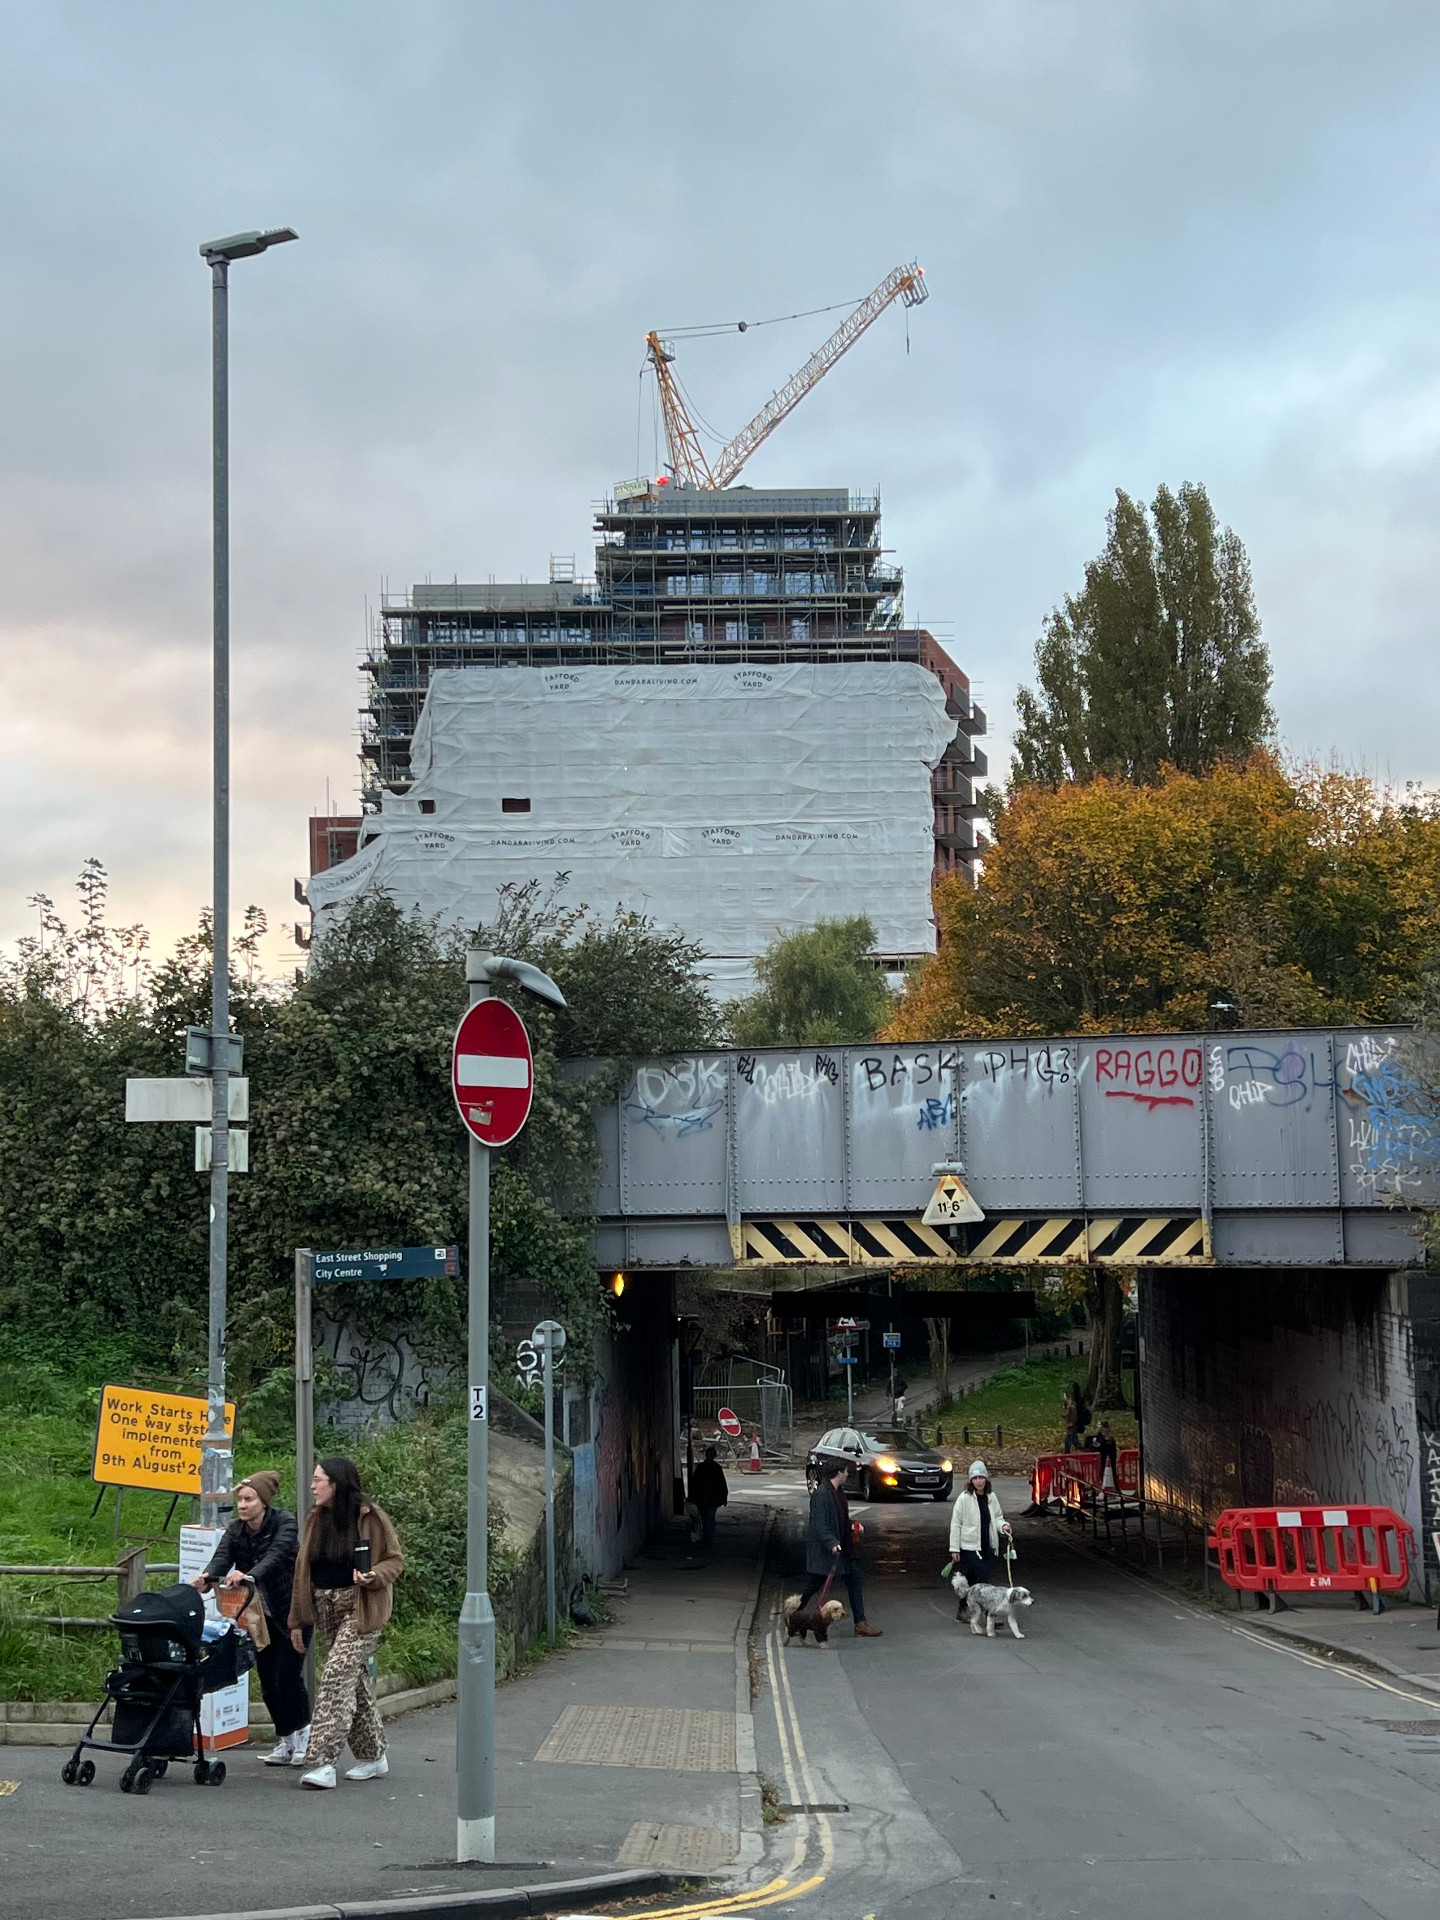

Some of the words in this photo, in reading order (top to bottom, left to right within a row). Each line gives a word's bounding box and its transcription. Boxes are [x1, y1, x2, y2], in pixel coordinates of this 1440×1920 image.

[545, 673, 579, 682] TAFFORD
[733, 671, 772, 681] STAFFORD
[414, 832, 456, 842] STAFFORD
[610, 829, 651, 840] STAFFORD
[700, 827, 740, 838] STAFFORD
[315, 1253, 334, 1263] East
[335, 1252, 362, 1262] Street
[363, 1251, 403, 1262] Shopping
[315, 1269, 333, 1280] City
[334, 1267, 363, 1278] Centre
[107, 1398, 142, 1413] Work
[150, 1403, 193, 1420] Starts
[200, 1411, 231, 1425] He
[111, 1413, 138, 1426] One
[145, 1418, 172, 1432] way
[122, 1428, 202, 1449] implemente
[150, 1445, 182, 1460] from
[102, 1453, 126, 1467] 9th
